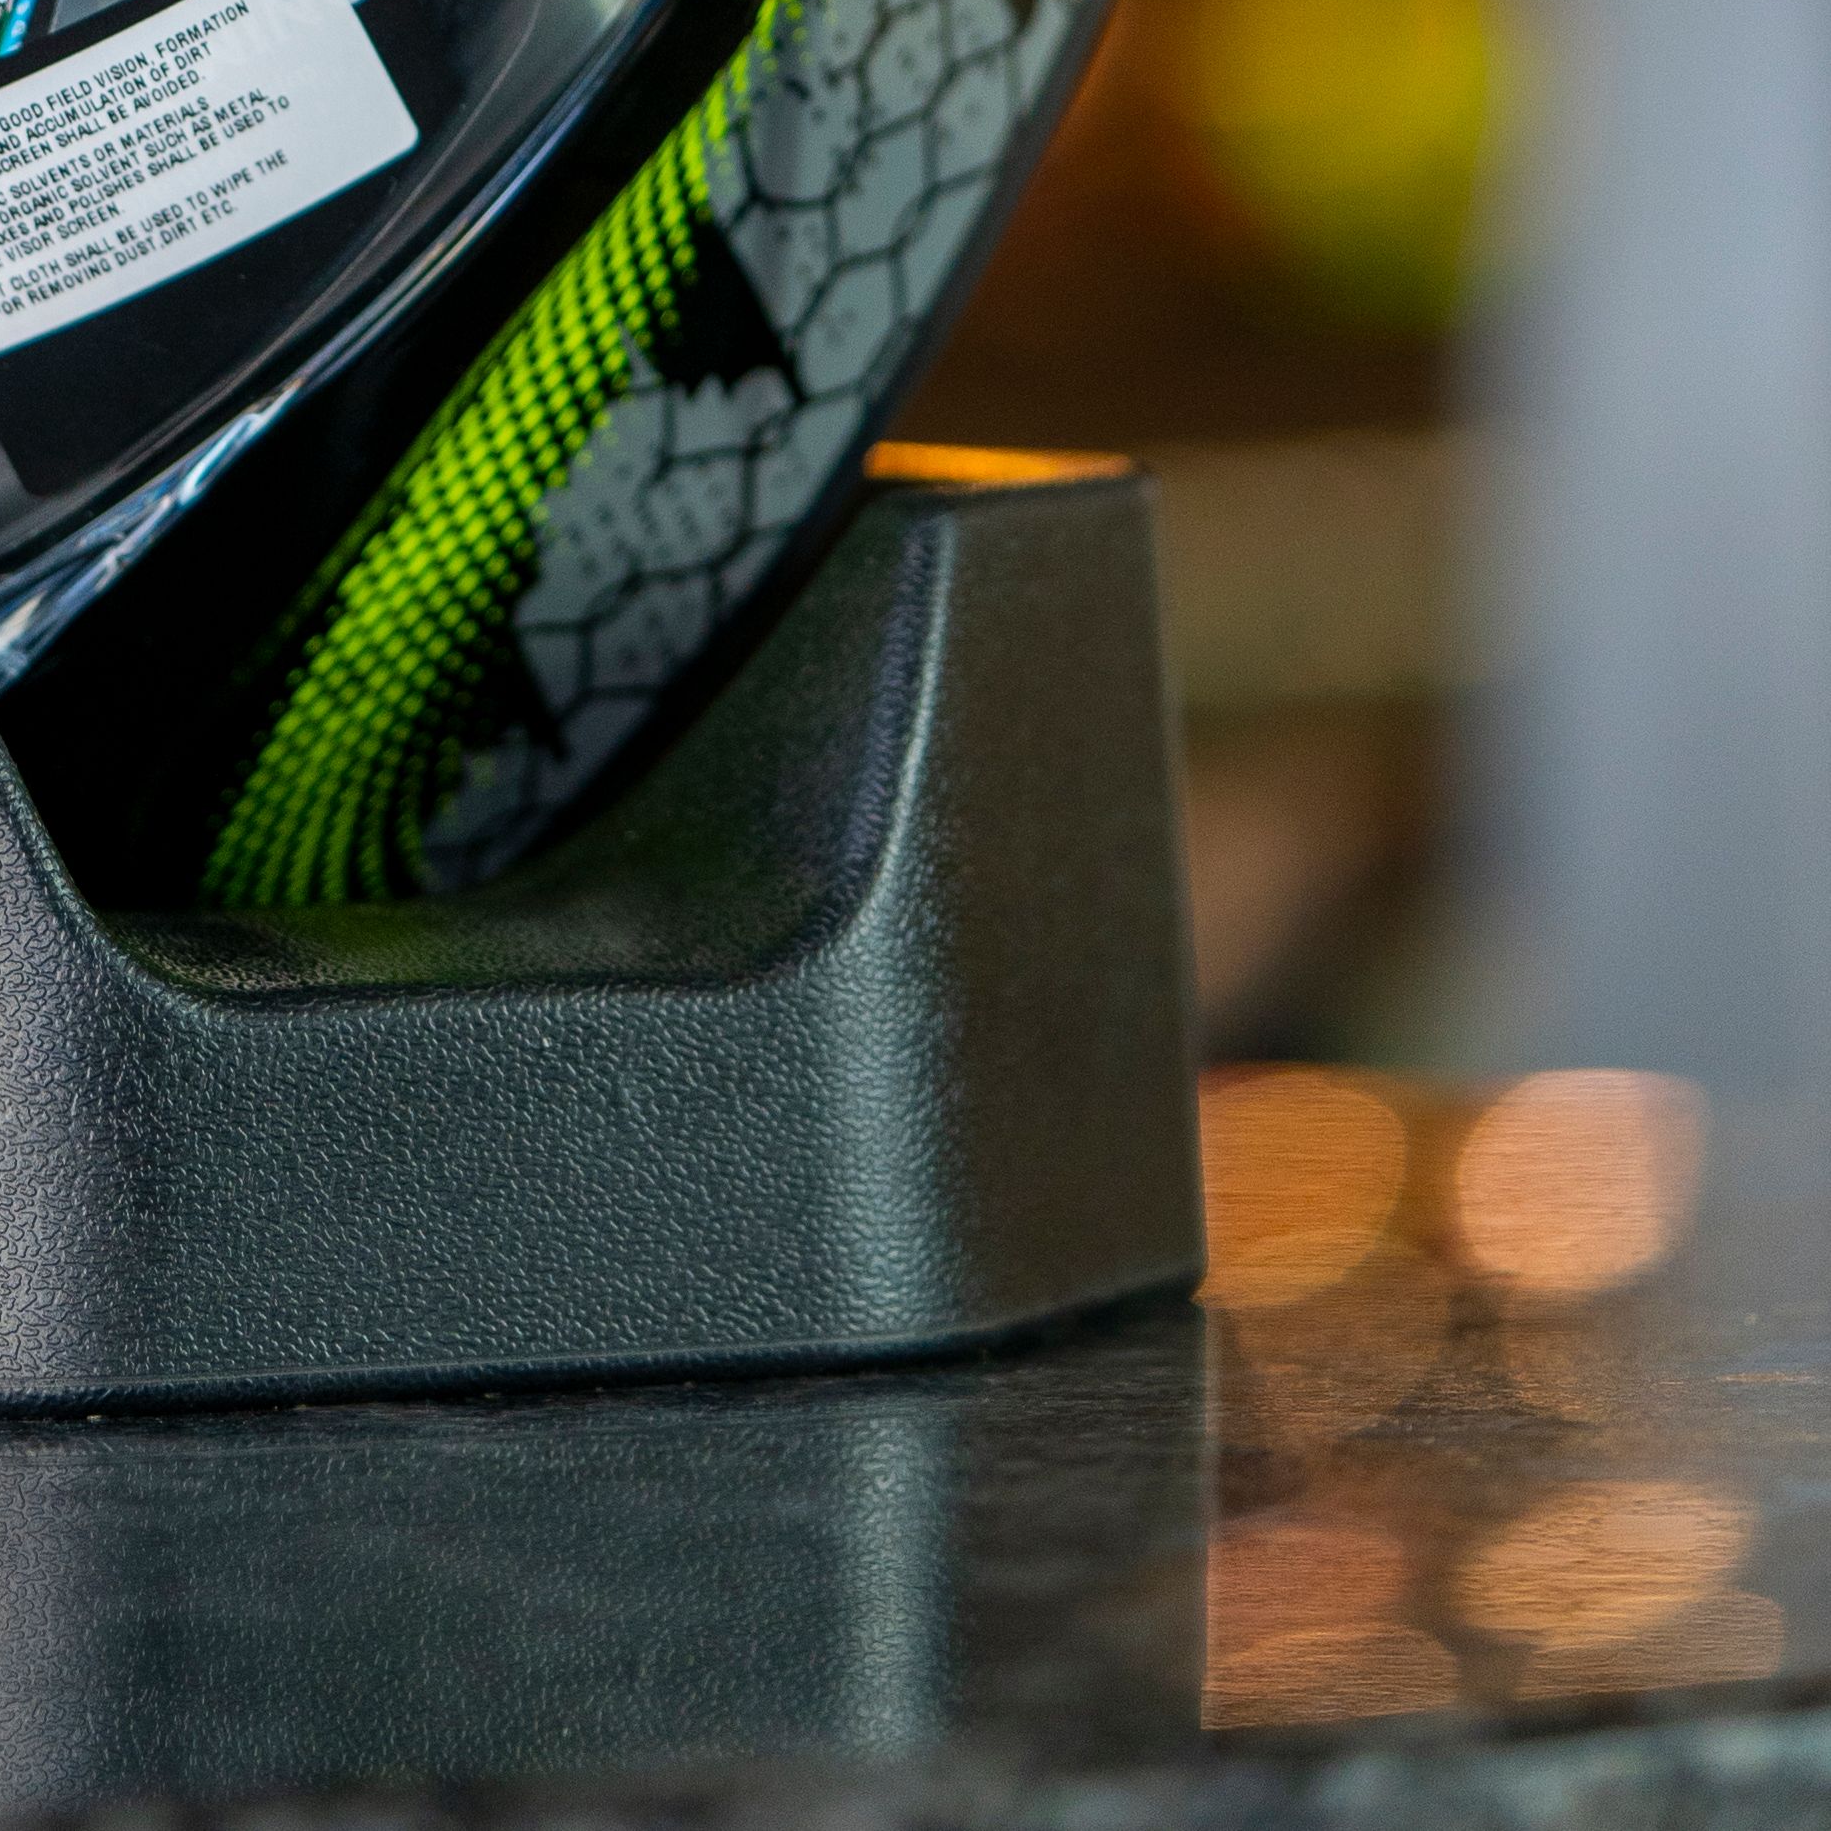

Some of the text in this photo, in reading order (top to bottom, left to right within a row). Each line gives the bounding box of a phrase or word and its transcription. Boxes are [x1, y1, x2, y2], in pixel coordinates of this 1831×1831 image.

[25, 74, 147, 143] ACCUMULATION
[149, 62, 170, 82] OF
[174, 41, 211, 70] DIRT
[45, 80, 93, 111] FIELD
[154, 0, 249, 58] FORMATION
[9, 154, 92, 200] SOLVENTS
[93, 142, 117, 162] OR
[119, 96, 210, 150] MATERIALS
[33, 206, 65, 231] AND
[67, 169, 145, 214] POLISHES
[147, 146, 197, 177] SHALL
[198, 132, 220, 151] BE
[222, 109, 265, 139] USED
[266, 95, 290, 114] TO
[54, 117, 106, 148] SHALL
[107, 104, 129, 124] BE
[70, 150, 140, 193] SOLVENT
[144, 128, 188, 158] SUCH
[191, 115, 212, 136] AS
[213, 88, 268, 124] METAL
[4, 231, 55, 262] VISOR
[9, 259, 62, 292] CLOTH
[64, 237, 115, 268] SHALL
[116, 225, 137, 245] BE
[140, 204, 183, 233] USED
[185, 191, 209, 210] TO
[209, 167, 254, 198] WIPE
[255, 149, 288, 174] THE
[26, 257, 112, 305] REMOVING
